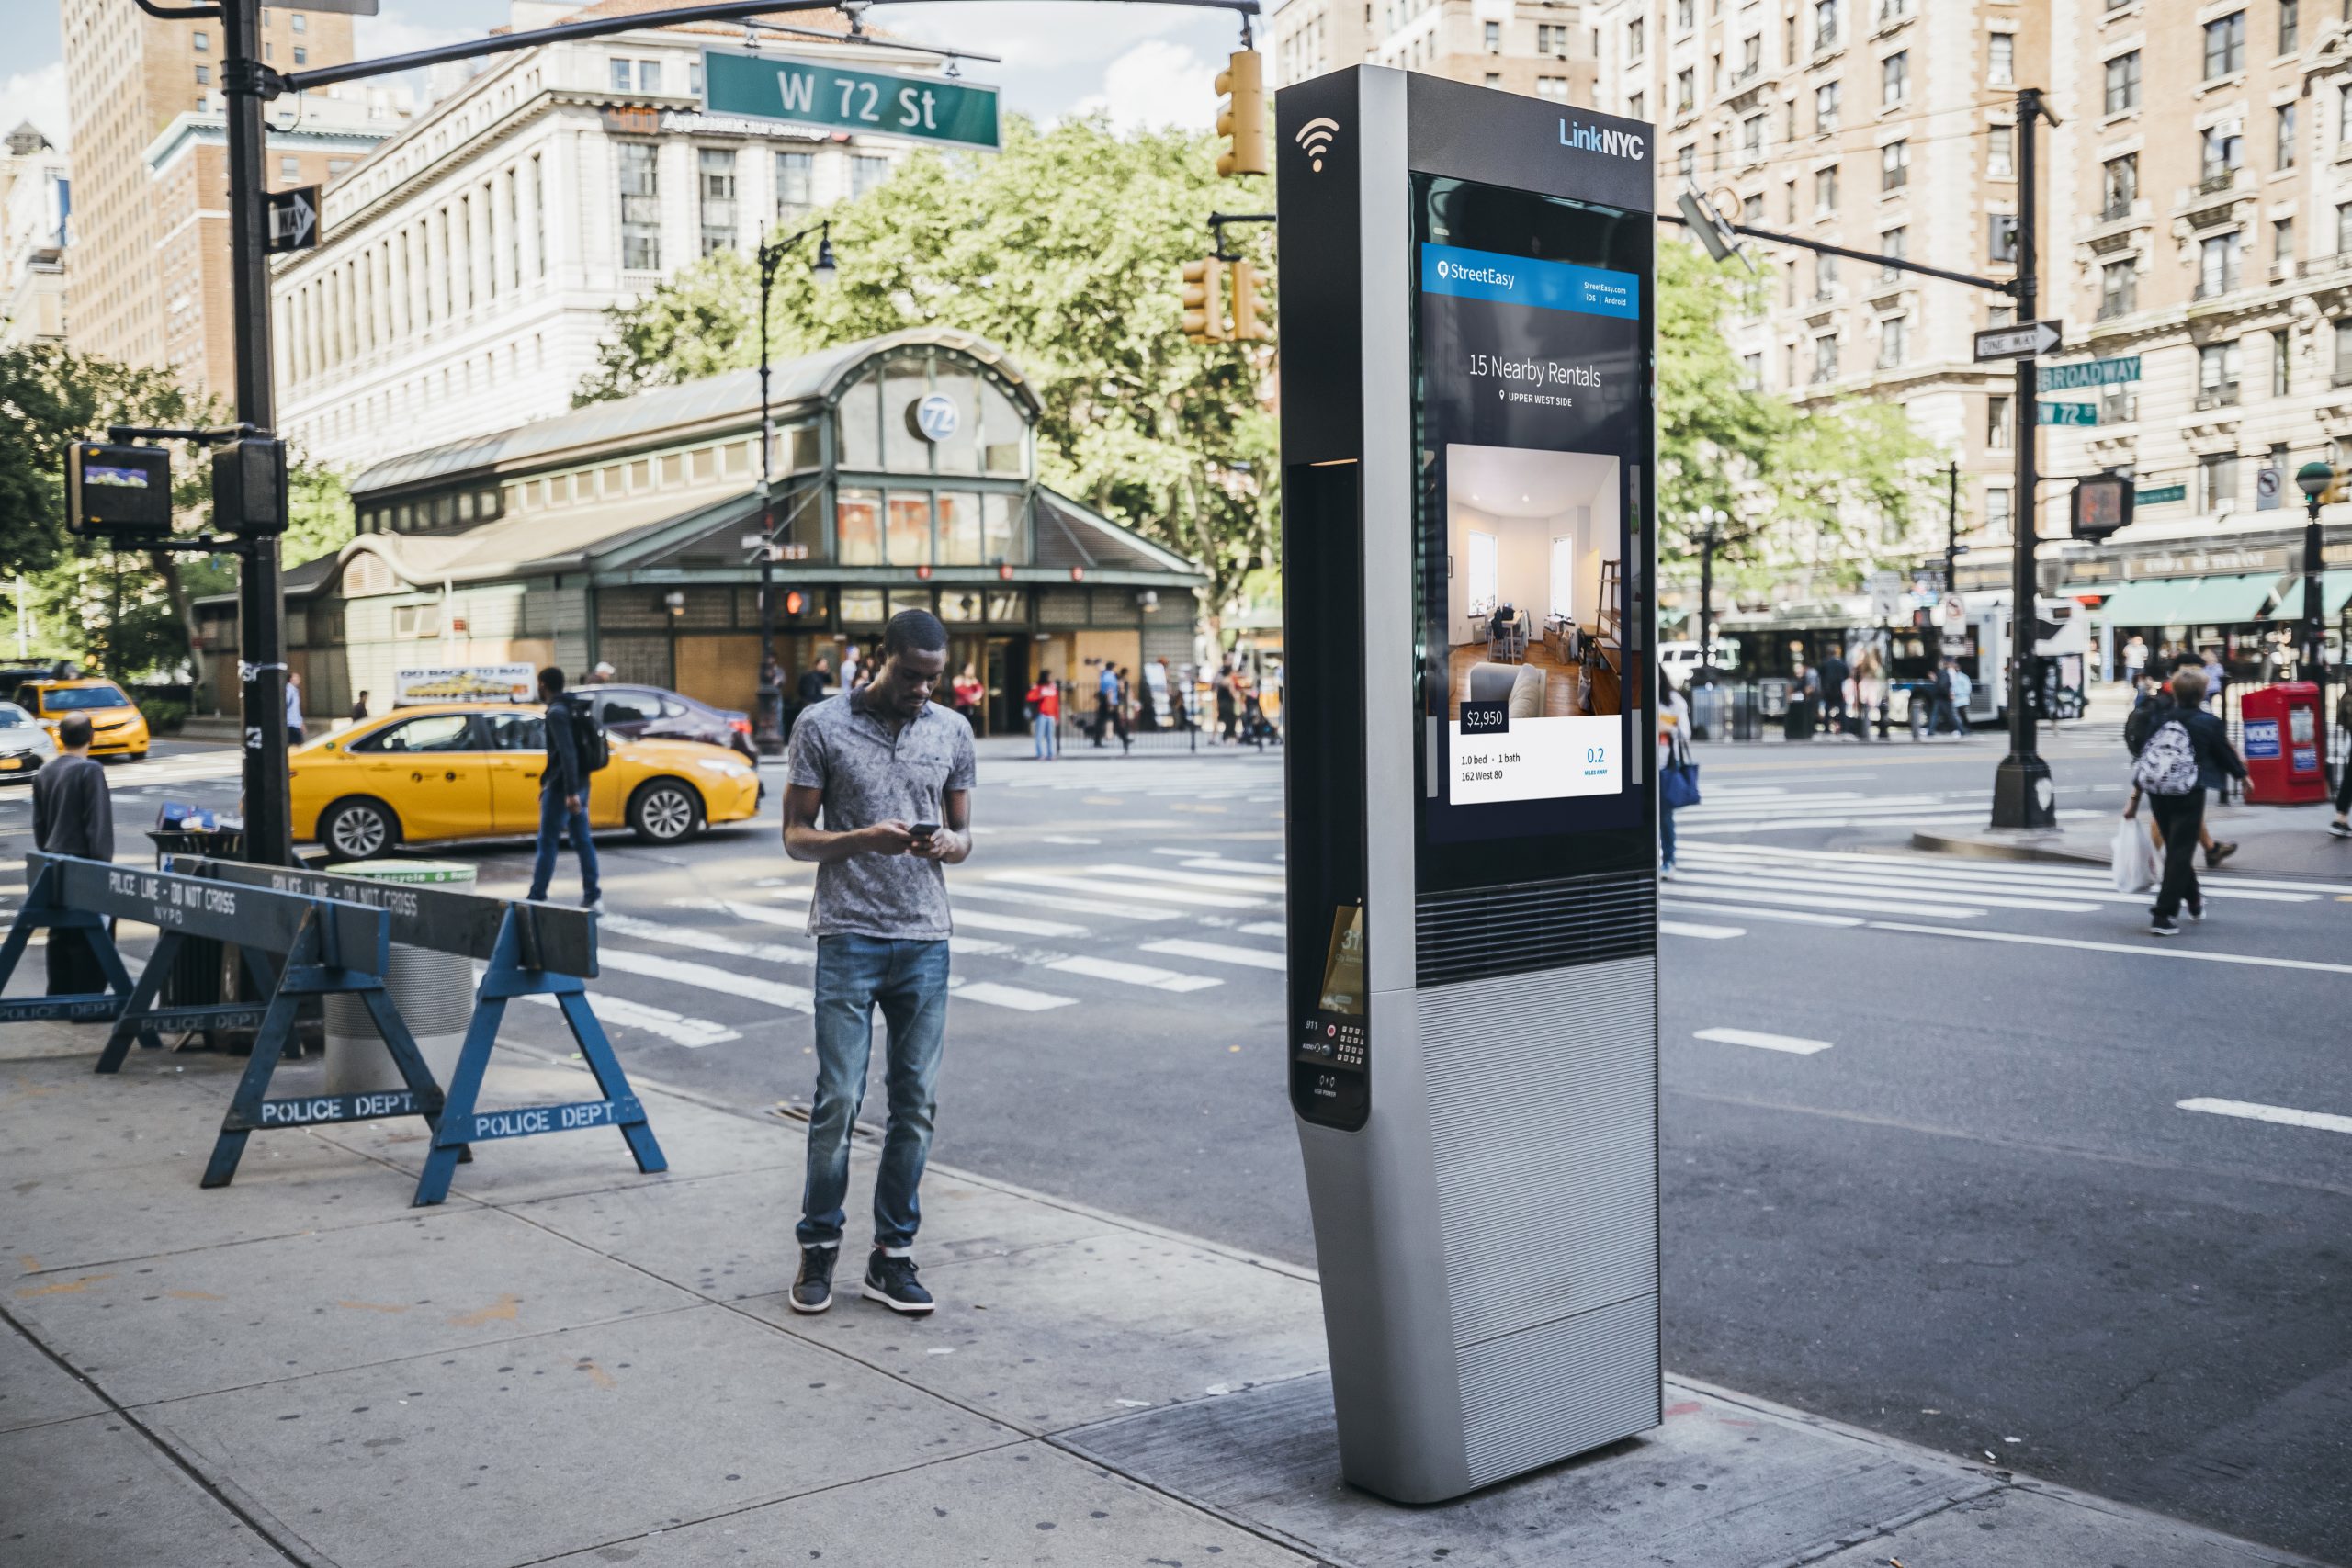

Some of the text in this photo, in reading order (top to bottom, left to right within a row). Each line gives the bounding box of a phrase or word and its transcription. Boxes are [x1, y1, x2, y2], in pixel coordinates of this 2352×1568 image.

[776, 71, 937, 130] W 72 St
[1560, 118, 1644, 161] LinkNYC
[279, 207, 308, 231] WAY
[1451, 264, 1515, 290] StreetEasy
[1584, 281, 1626, 294] StreetEasy.com
[1586, 293, 1596, 302] iOS
[1604, 296, 1626, 306] Android
[1982, 333, 2037, 354] ONE WAY
[1469, 354, 1601, 388] 15 Nearby Rentals
[2041, 358, 2139, 391] BROADWAY
[1509, 392, 1572, 407] UPPER WEST SIDE
[923, 402, 955, 432] 72
[2041, 404, 2055, 423] W
[2059, 404, 2080, 425] 72
[1467, 710, 1503, 728] $2,950
[2245, 726, 2279, 742] VOICE
[1462, 753, 1521, 766] 1.0 bed 1 bath
[1587, 748, 1604, 763] 0.2
[1462, 770, 1503, 782] 162 West 80
[375, 873, 425, 883] Recycle
[109, 871, 136, 896] POLICE
[140, 876, 159, 900] LINE
[170, 882, 182, 905] DO
[185, 885, 203, 908] NOT
[205, 887, 235, 915] CROSS
[383, 889, 417, 917] CROSS
[154, 906, 183, 925] NYPD
[141, 1015, 205, 1031] POLICE
[1306, 1020, 1317, 1030] 911
[261, 1098, 343, 1122] POLICE
[475, 1110, 550, 1138] POLICE
